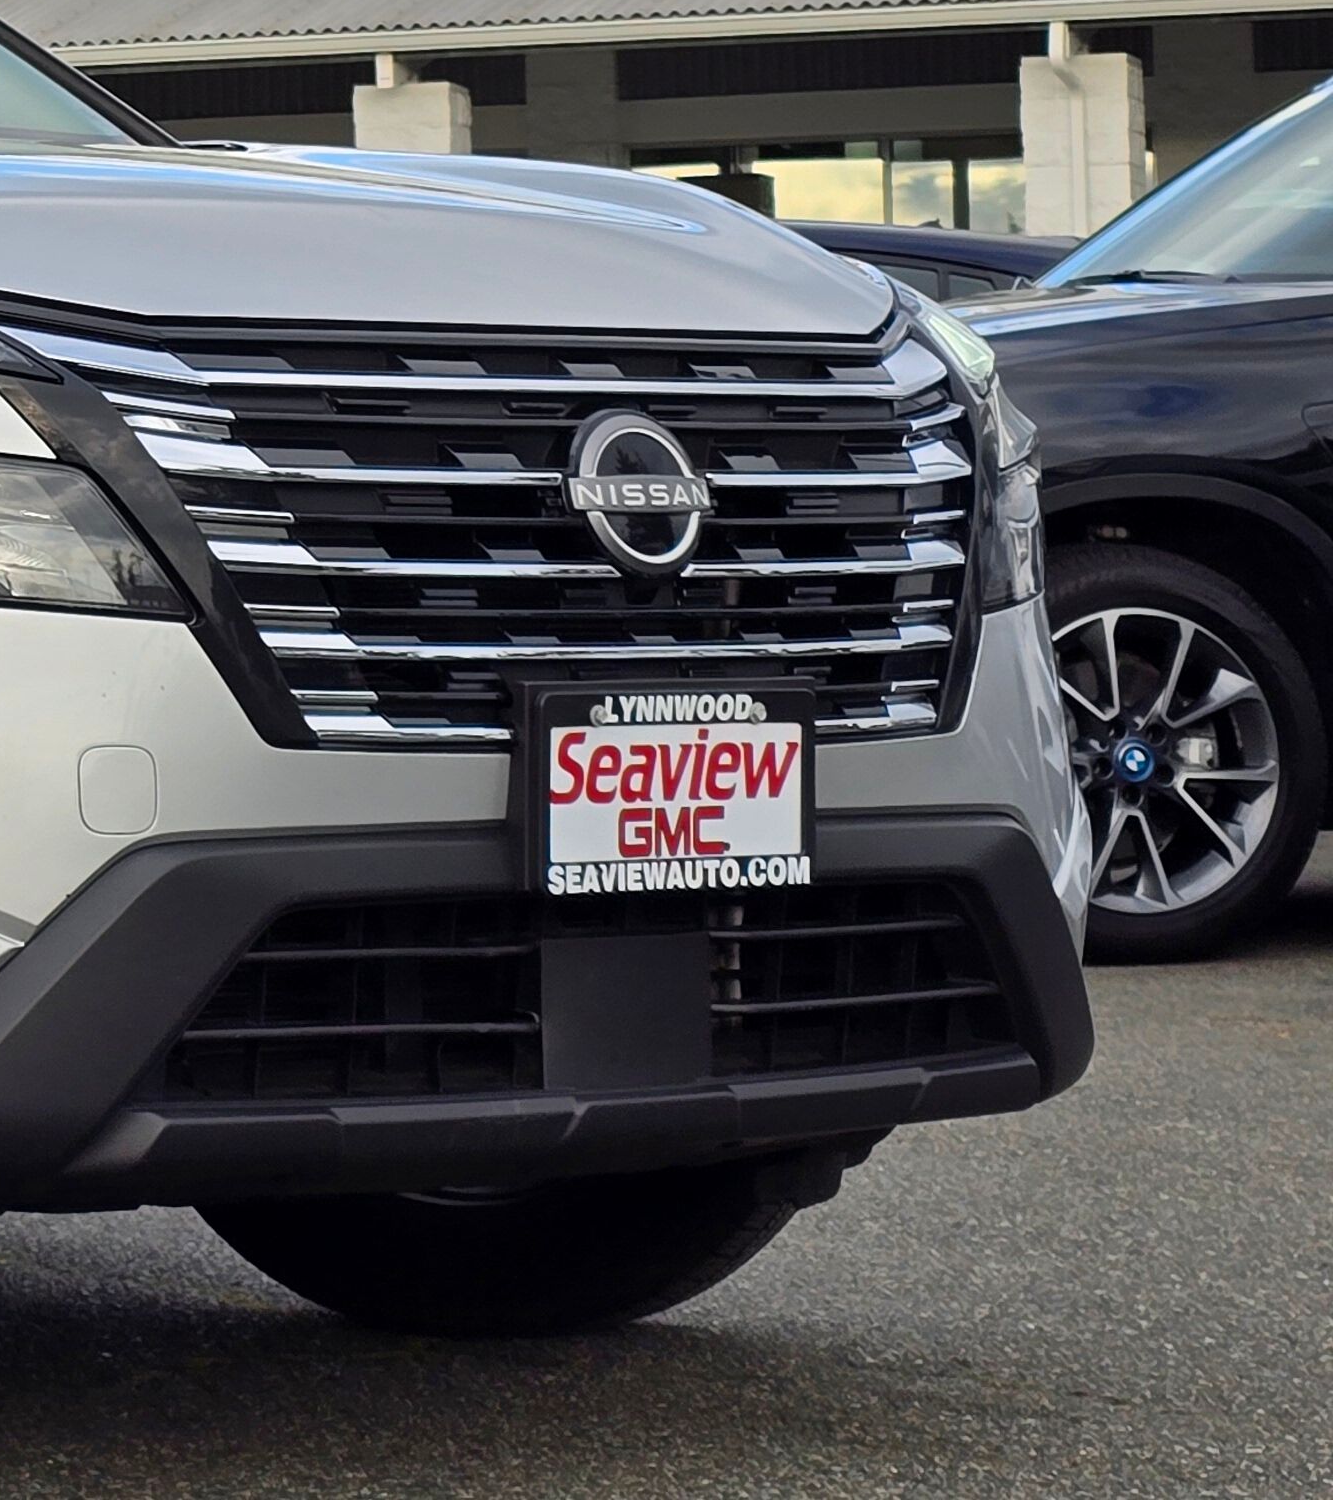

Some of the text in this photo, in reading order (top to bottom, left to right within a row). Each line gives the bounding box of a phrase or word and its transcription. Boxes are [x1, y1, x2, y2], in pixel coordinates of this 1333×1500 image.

[576, 484, 711, 506] NISSAN
[604, 693, 753, 724] LYNNWOOD
[549, 728, 799, 804] Seaview
[617, 805, 729, 858] GMC
[547, 856, 811, 895] SEAVIEWAUTO.COM
